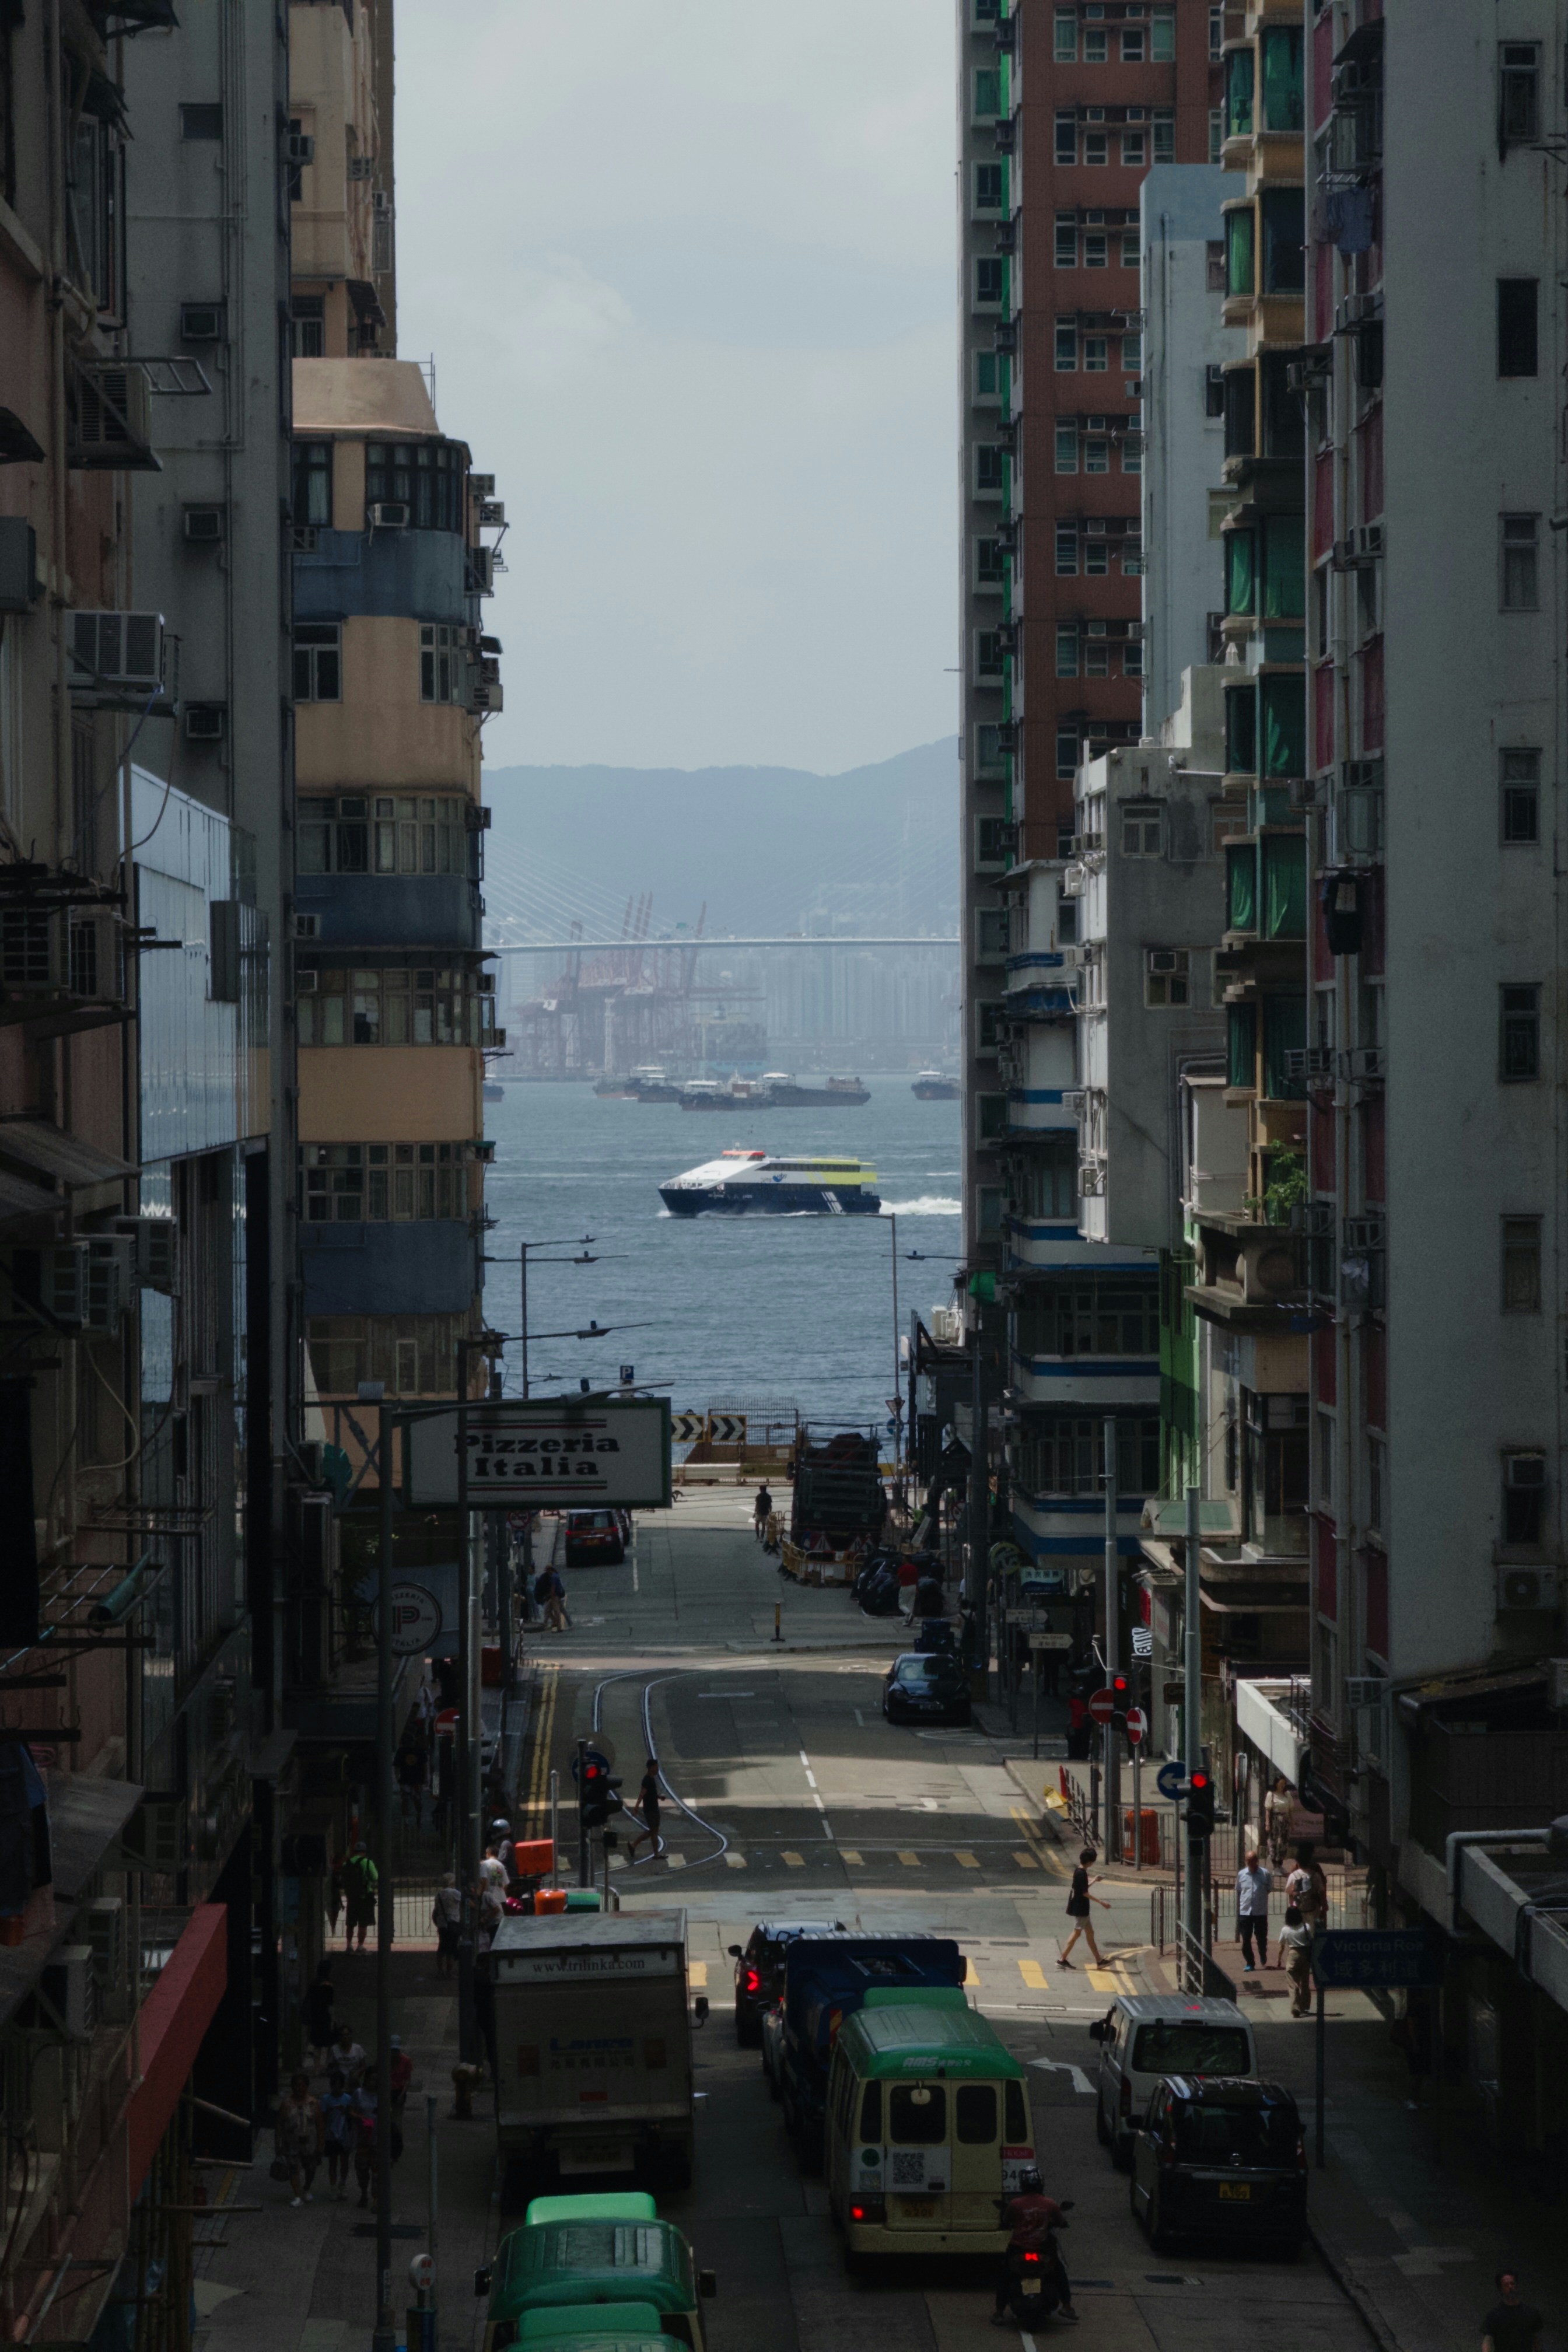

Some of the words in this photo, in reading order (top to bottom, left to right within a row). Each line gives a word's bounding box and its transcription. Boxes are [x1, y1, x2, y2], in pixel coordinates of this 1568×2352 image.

[622, 1367, 632, 1379] P
[454, 1433, 620, 1453] Pizzeria
[475, 1457, 598, 1476] Italia
[1333, 1940, 1391, 1952] Victoria
[1334, 1958, 1419, 1978] 域多利道
[903, 2057, 939, 2067] AMS
